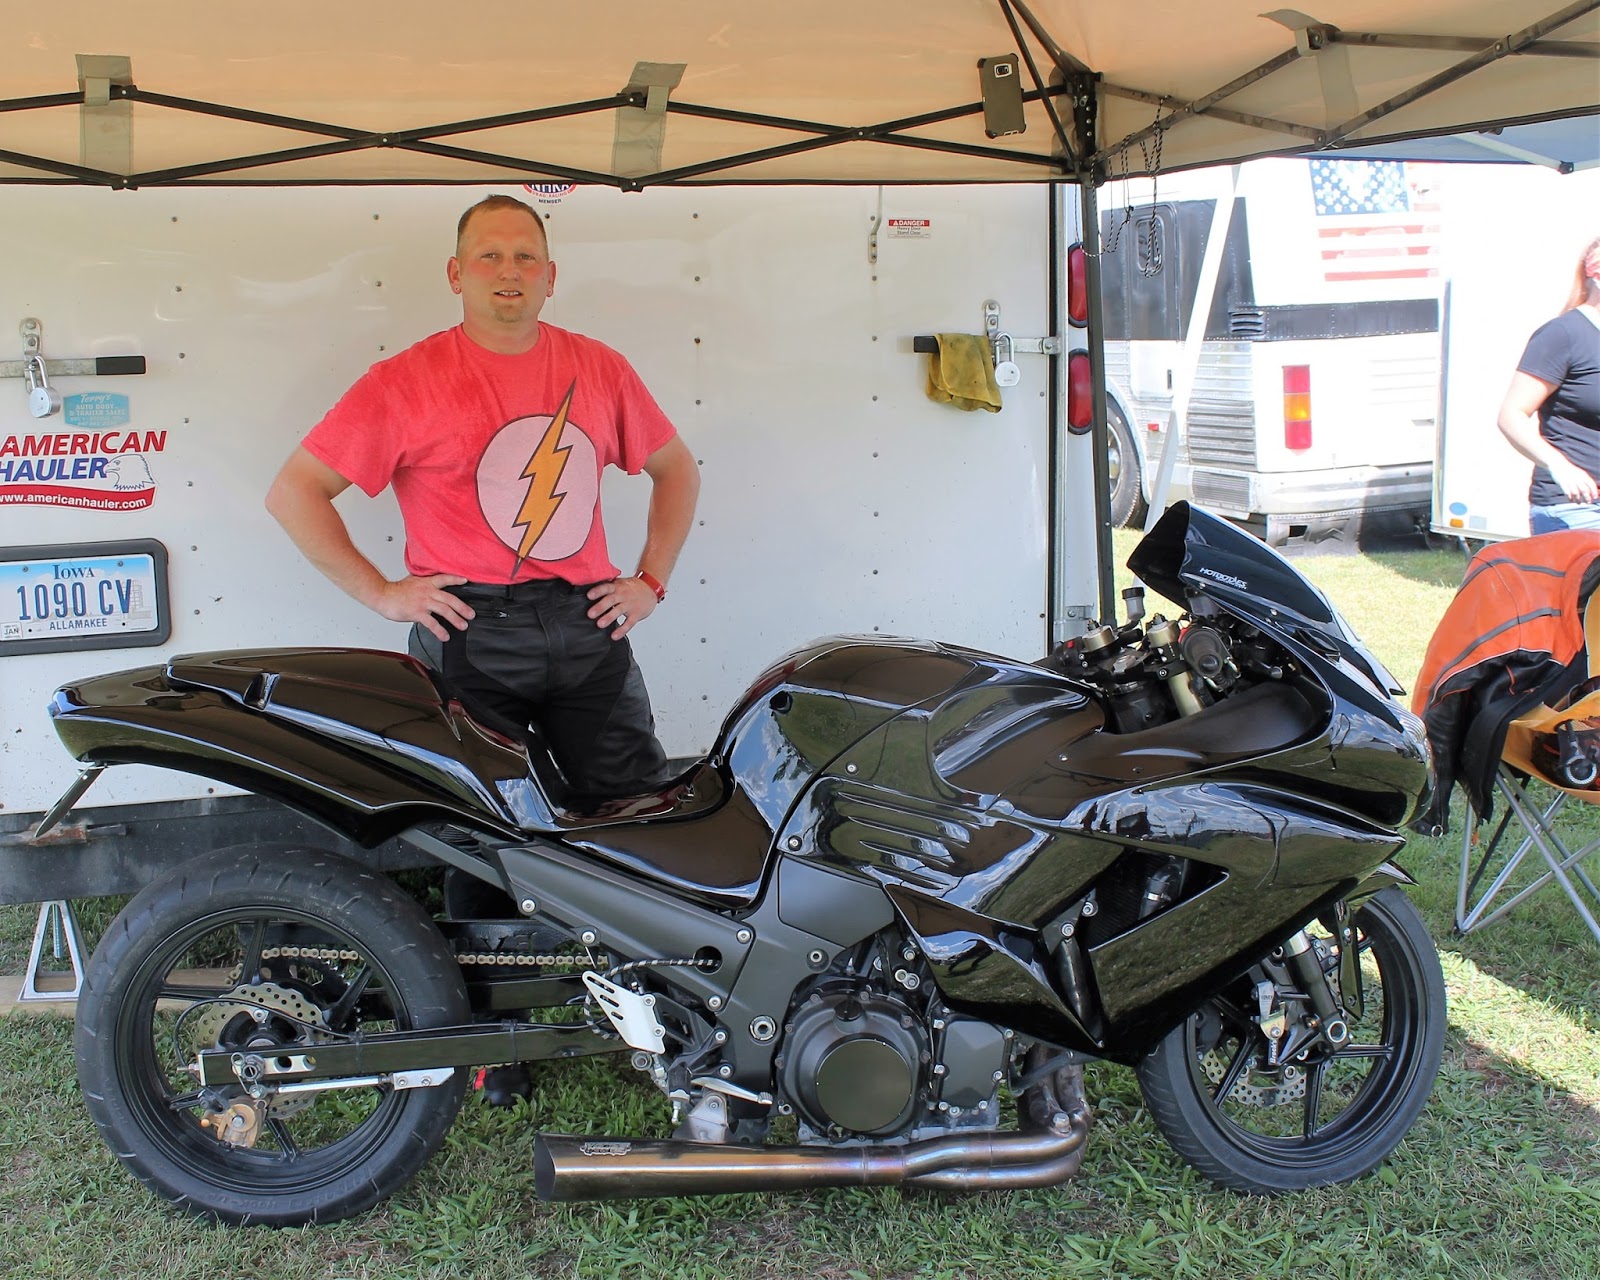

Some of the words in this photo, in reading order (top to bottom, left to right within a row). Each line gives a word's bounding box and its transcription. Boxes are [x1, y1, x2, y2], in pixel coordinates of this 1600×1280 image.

[0, 430, 167, 457] AMERICAN
[0, 457, 109, 482] HAULER
[17, 581, 87, 620] 1090
[98, 579, 132, 616] CV
[49, 618, 108, 631] ALLAMAKEE
